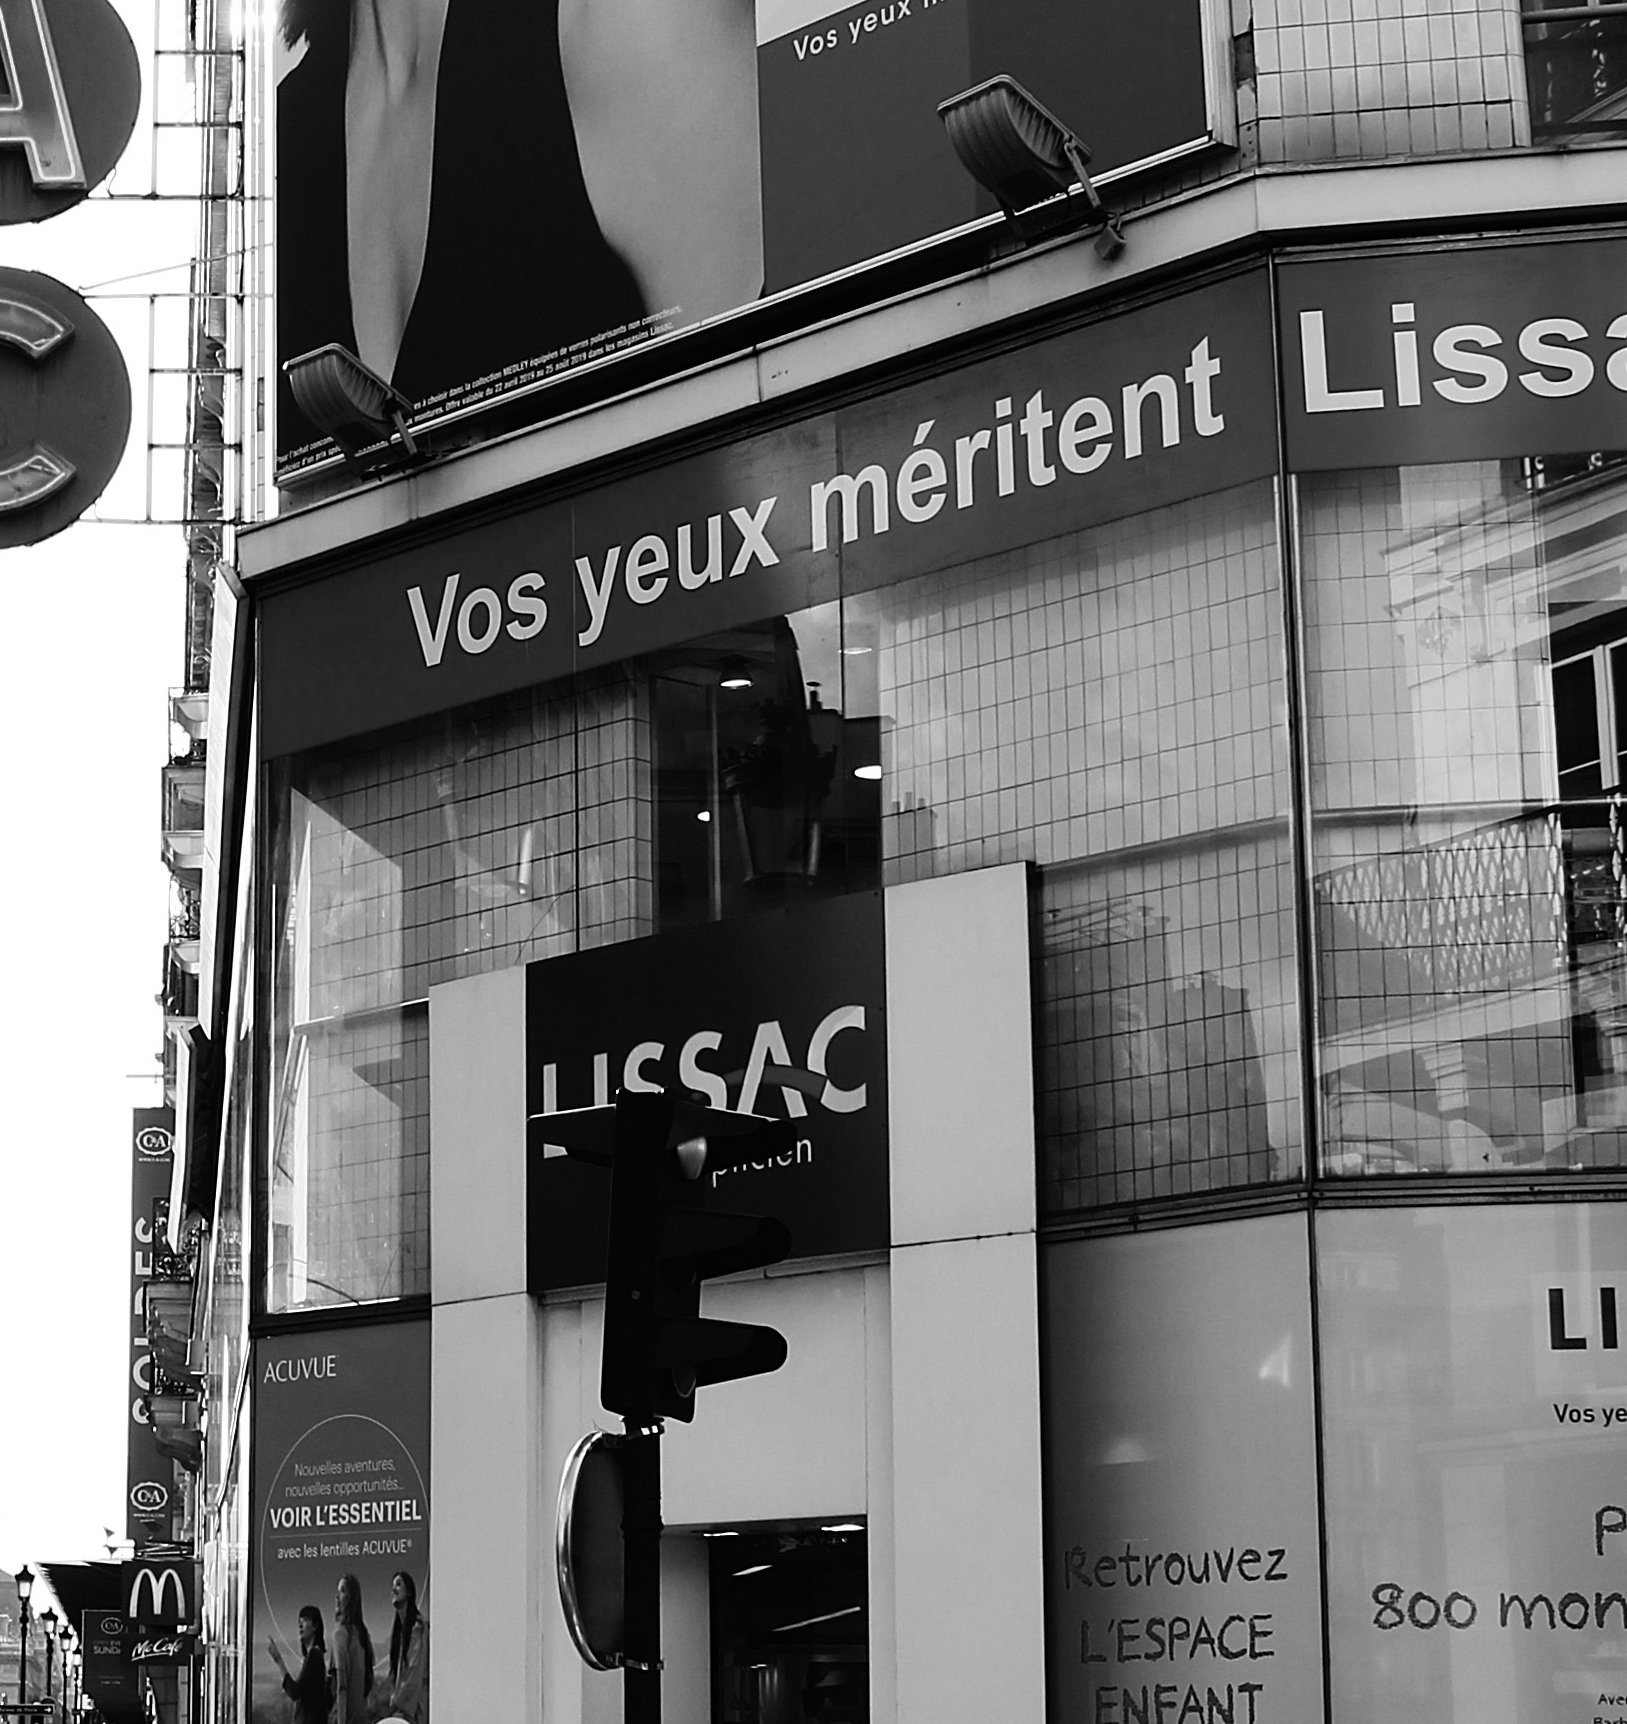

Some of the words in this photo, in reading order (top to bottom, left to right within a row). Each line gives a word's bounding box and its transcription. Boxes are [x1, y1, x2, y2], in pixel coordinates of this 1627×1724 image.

[793, 27, 838, 62] Vos
[502, 358, 528, 378] MEDLEY
[405, 568, 549, 670] Vos
[575, 491, 783, 650] yeux
[809, 335, 1226, 548] méritent
[263, 1355, 336, 1383] ACUVUE
[1553, 1402, 1595, 1425] Vos
[1601, 1407, 1627, 1429] ye
[294, 1461, 342, 1477] Nouvelles
[344, 1458, 395, 1475] aventures,
[286, 1482, 330, 1498] nouvelles
[270, 1506, 311, 1528] VOIR
[316, 1499, 421, 1526] L'ESSENTIEL
[277, 1546, 301, 1559] avec
[303, 1544, 318, 1558] les
[320, 1541, 360, 1557] lentilles
[1064, 1544, 1289, 1589] Retrouvez
[1371, 1582, 1477, 1631] 800
[1080, 1614, 1275, 1664] L'ESPACE
